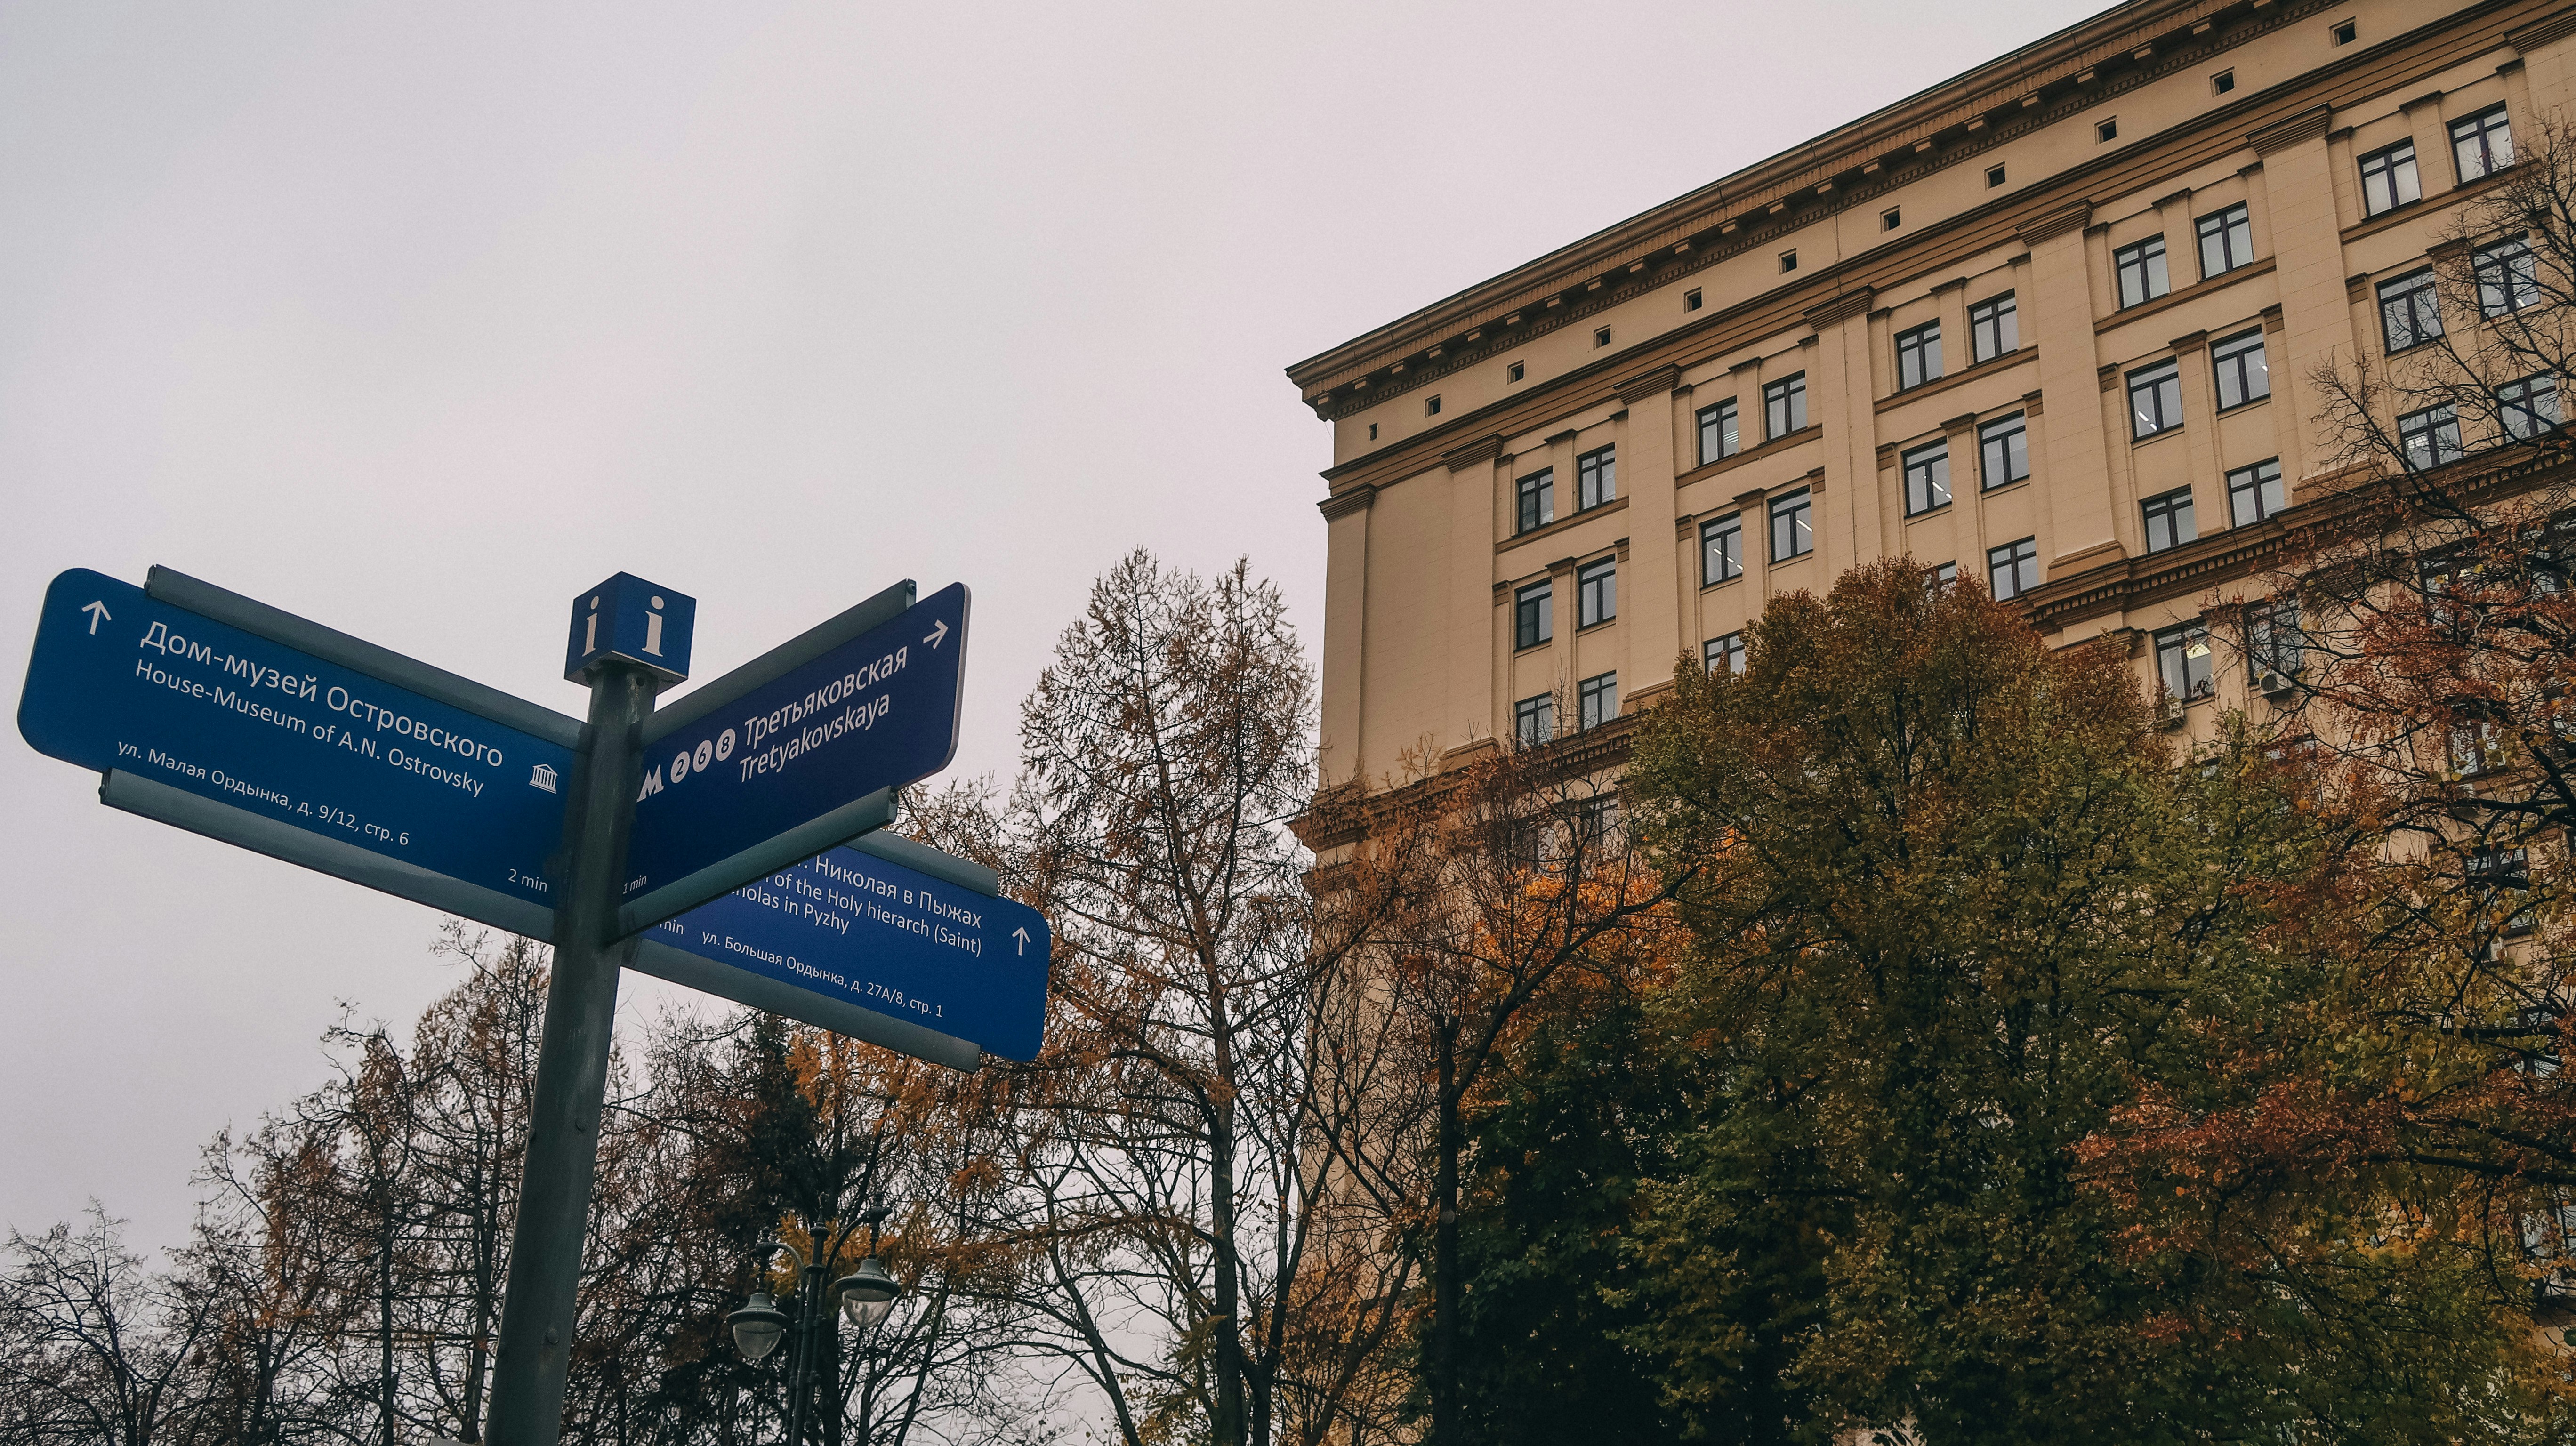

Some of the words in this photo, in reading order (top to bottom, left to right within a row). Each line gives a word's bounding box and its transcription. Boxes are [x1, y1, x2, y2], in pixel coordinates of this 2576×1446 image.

[136, 659, 306, 734] House-Museum
[313, 725, 336, 742] of
[338, 731, 380, 760] A.N.
[388, 748, 484, 797] Ostrovsky
[140, 621, 317, 702] Дом-музей
[327, 686, 503, 767] Островского
[744, 646, 908, 750] Третьяковская
[740, 694, 889, 782] Tretyakovskaya
[119, 741, 141, 758] ул.
[148, 748, 206, 779] Малая
[211, 770, 292, 810] Ордынка,
[297, 802, 313, 816] д.
[319, 805, 359, 832] 9/12,
[365, 823, 394, 841] стр.
[400, 832, 409, 845] 6
[508, 868, 516, 882] 2
[522, 876, 547, 892] min
[623, 882, 628, 894] 1
[630, 875, 646, 891] min
[774, 874, 793, 889] of
[796, 878, 822, 900] the
[828, 888, 863, 917] Holy
[867, 900, 929, 937] hierarch
[934, 924, 981, 957] (Saint)
[784, 896, 798, 916] in
[804, 903, 850, 935] Pyzhy
[815, 855, 897, 900] Николая
[903, 890, 913, 904] в
[919, 891, 982, 929] Пыжах
[702, 931, 720, 946] ул.
[725, 936, 782, 965] Большая
[786, 956, 847, 988] Ордынка,
[850, 980, 862, 994] д.
[867, 982, 906, 1007] 27А/8,
[910, 999, 932, 1014] стр.
[936, 1005, 942, 1017] 1
